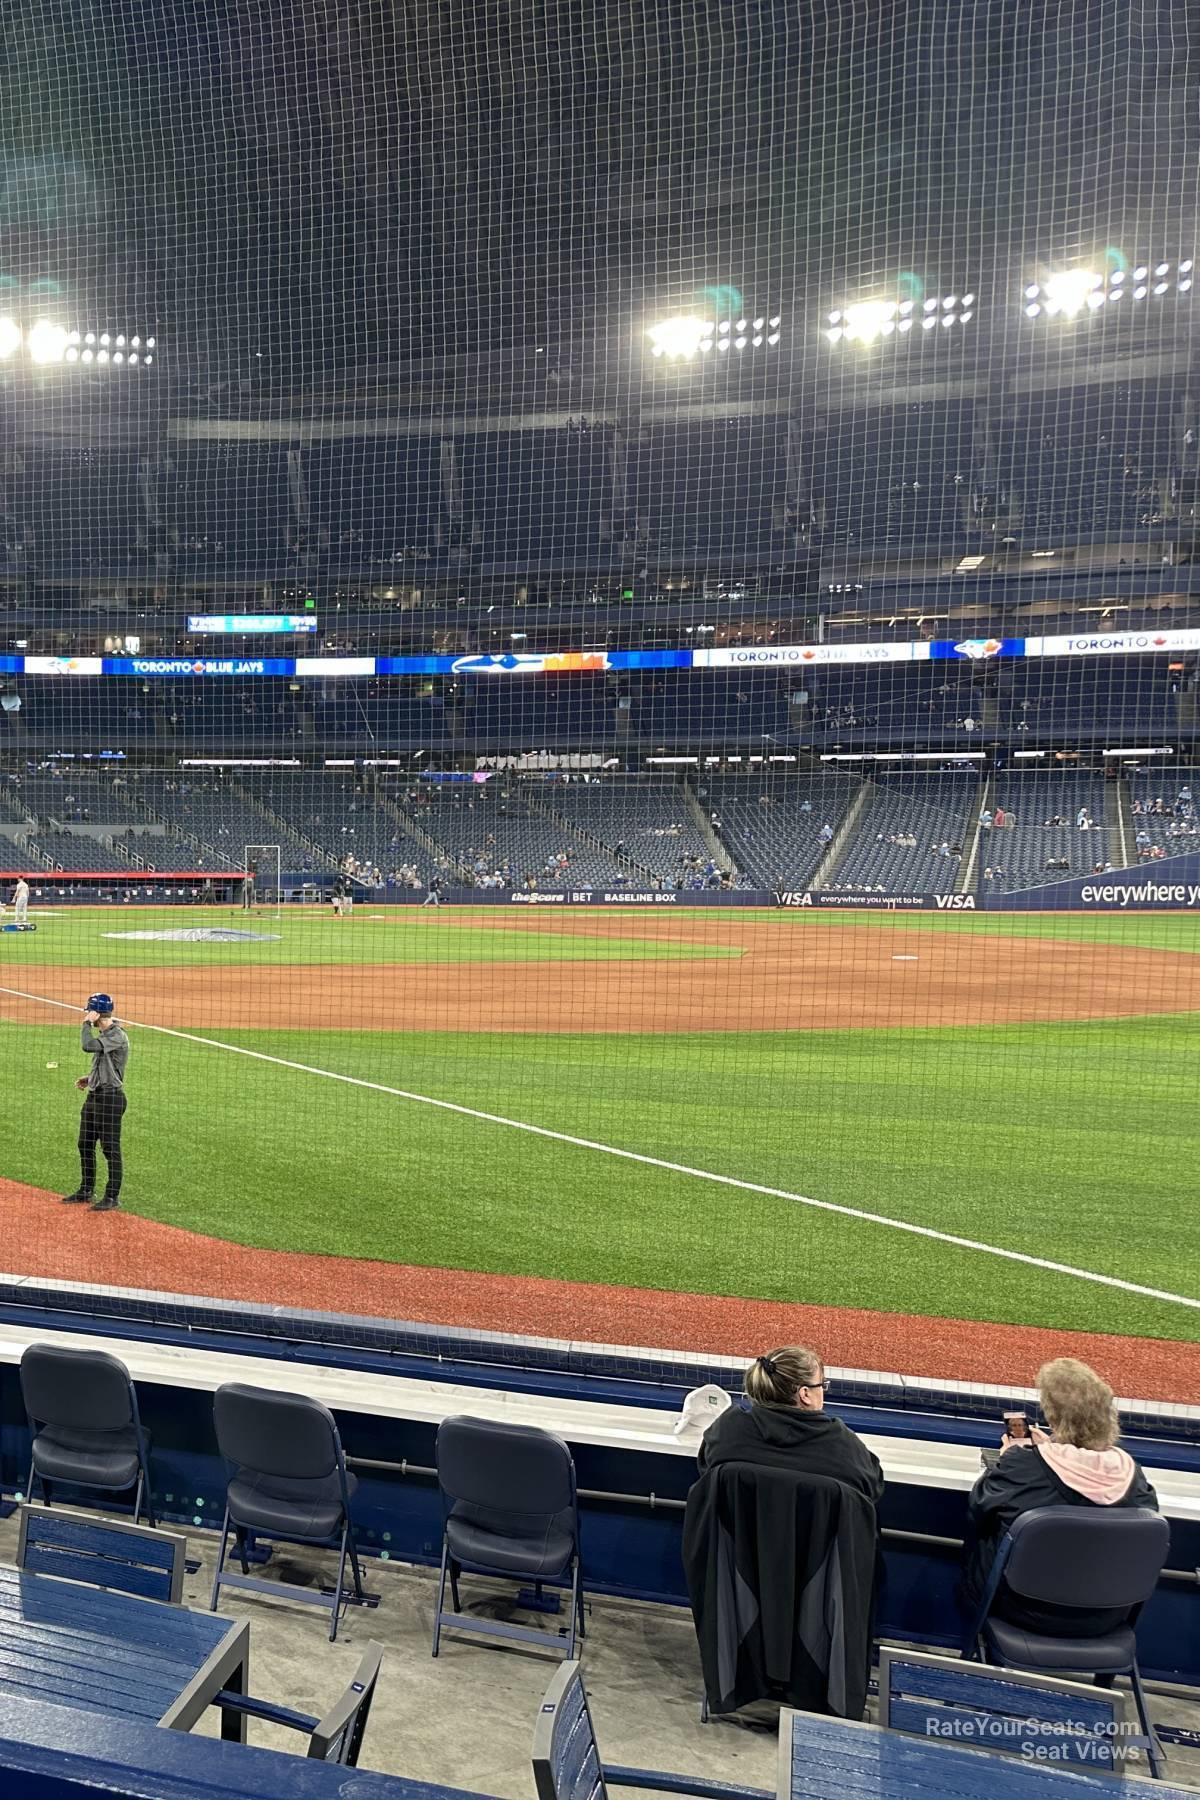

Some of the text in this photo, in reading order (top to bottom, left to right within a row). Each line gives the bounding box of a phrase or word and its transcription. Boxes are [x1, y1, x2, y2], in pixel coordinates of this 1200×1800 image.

[1068, 636, 1148, 651] TORONTO
[729, 649, 799, 663] TORONTO
[132, 661, 264, 673] TORONTO BLUE JAYS
[511, 892, 593, 902] theScore BET
[604, 893, 676, 902] BASELINE BOX
[772, 891, 813, 906] VISA
[820, 895, 866, 904] everywhere
[866, 897, 881, 905] you
[912, 896, 924, 904] be
[1081, 880, 1200, 906] everywhere y
[931, 894, 976, 909] VISA
